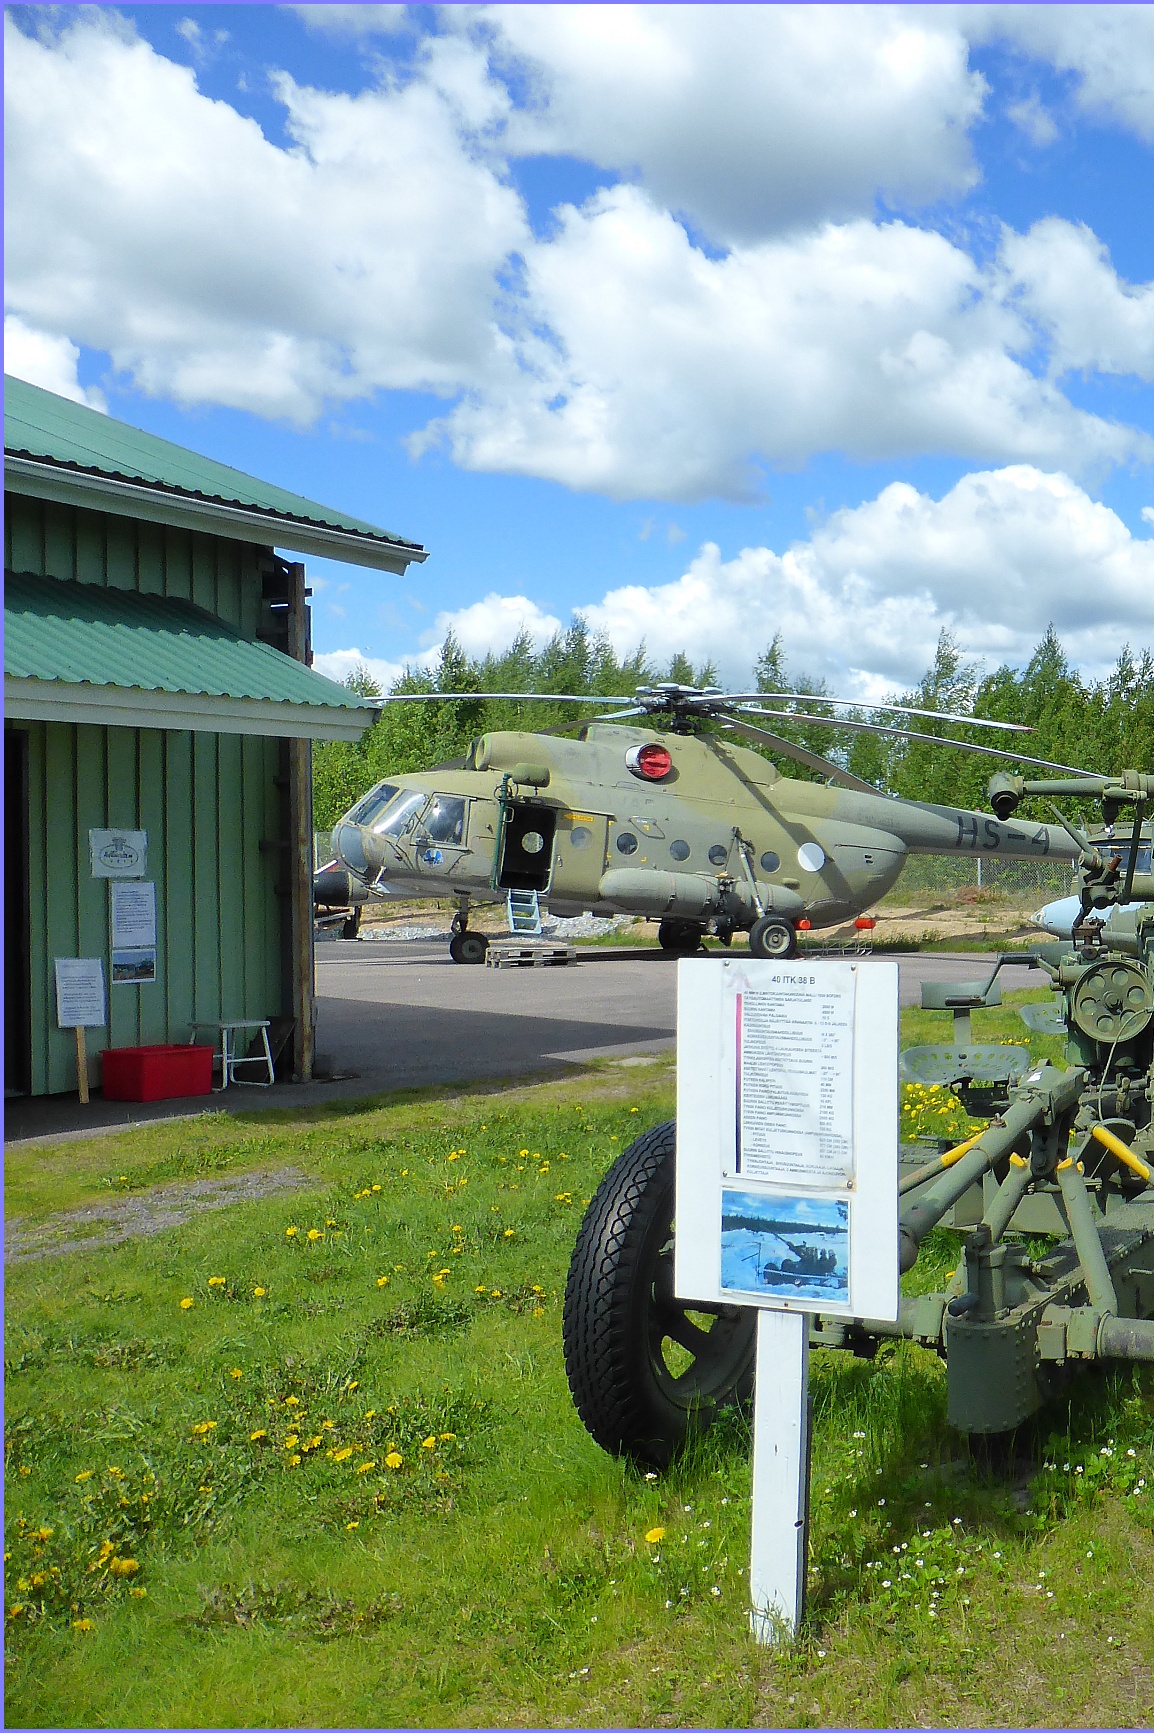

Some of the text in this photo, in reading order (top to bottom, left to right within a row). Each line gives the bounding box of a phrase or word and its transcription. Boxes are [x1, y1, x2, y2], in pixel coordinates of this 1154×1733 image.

[955, 815, 1050, 855] HS-4
[772, 975, 781, 984] 40
[783, 976, 797, 984] ITK
[809, 976, 816, 985] B
